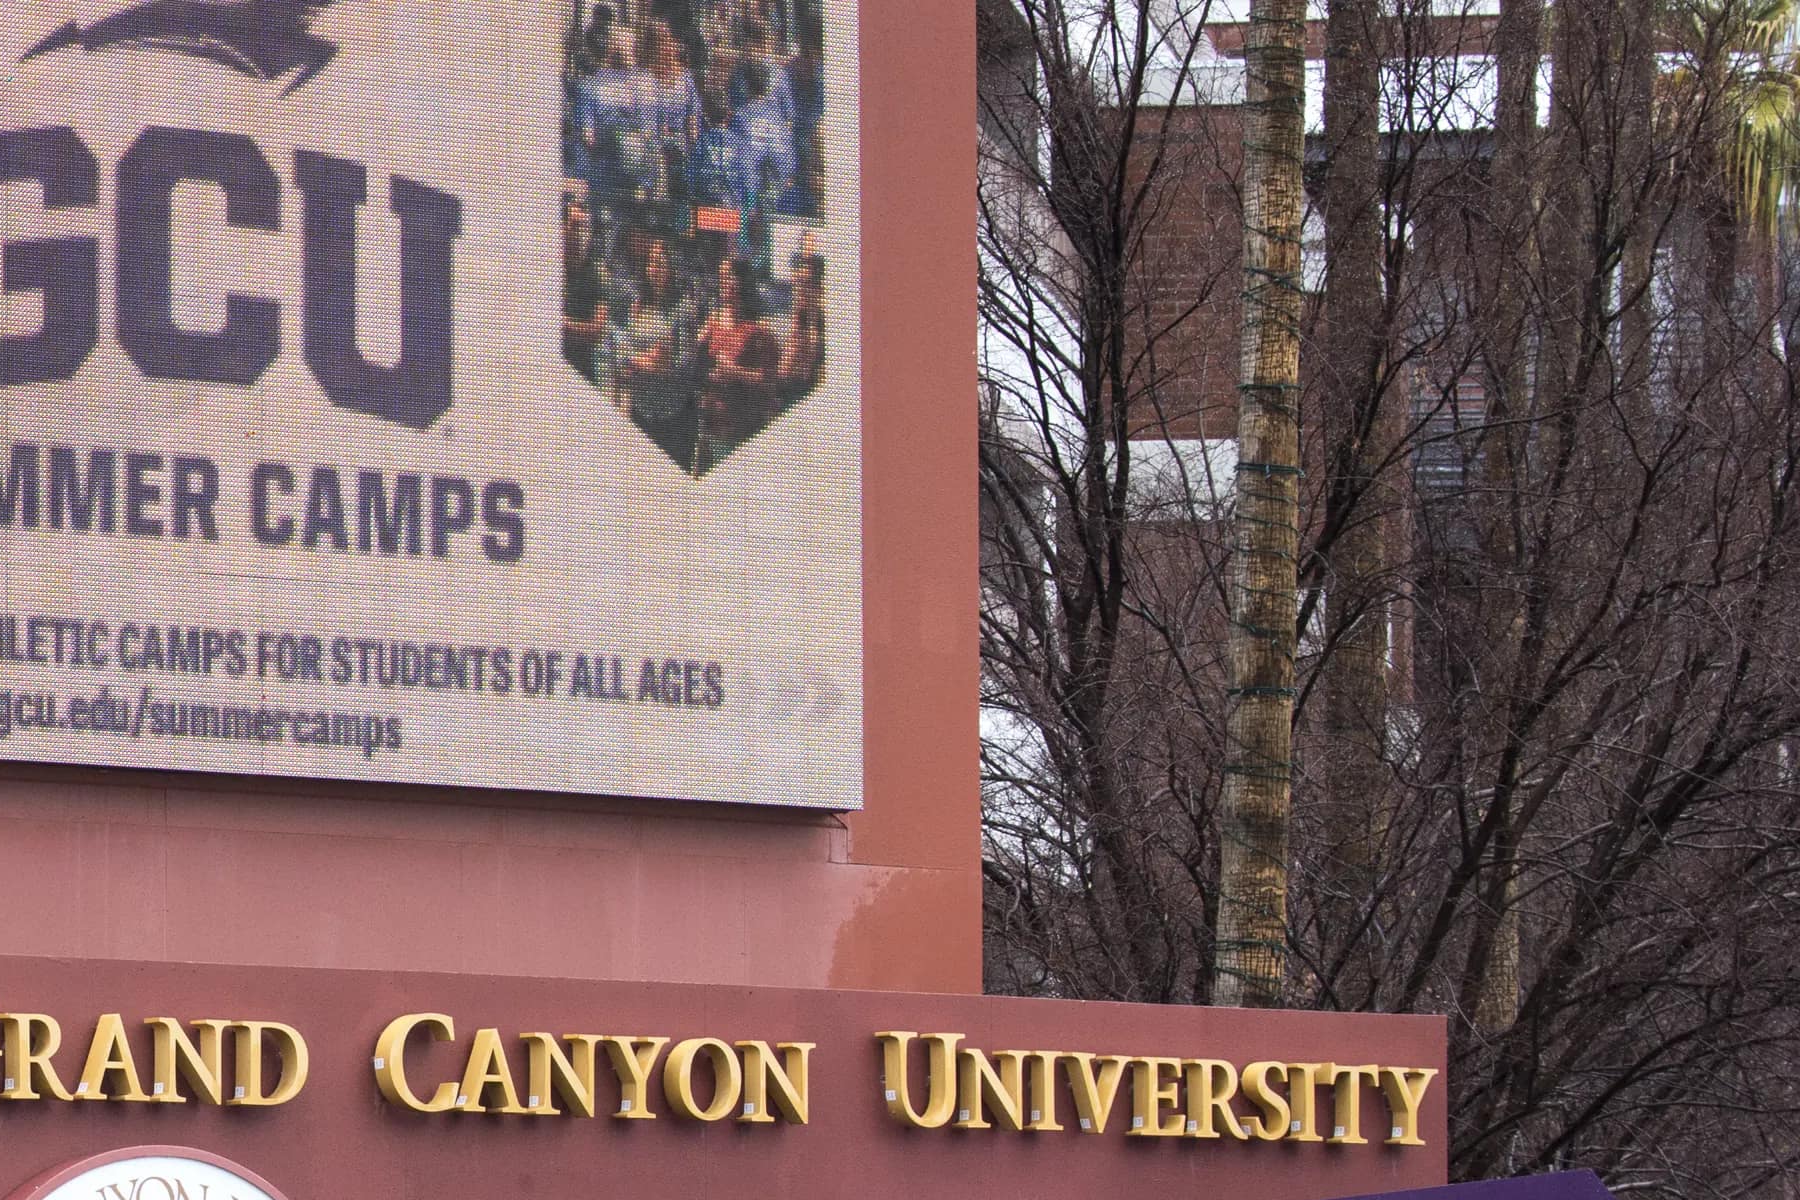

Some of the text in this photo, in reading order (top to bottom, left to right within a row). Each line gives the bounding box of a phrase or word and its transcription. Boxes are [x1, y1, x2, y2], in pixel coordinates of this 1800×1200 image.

[250, 462, 525, 563] CAMPS
[119, 622, 246, 676] CAMPS
[258, 632, 323, 681] FOR
[332, 636, 513, 694] STUDENTS
[521, 649, 563, 700] OF
[571, 652, 629, 702] ALL
[638, 658, 724, 708] AGES
[374, 1012, 816, 1124] CANYON
[875, 1031, 1438, 1146] UNIVERSITY
